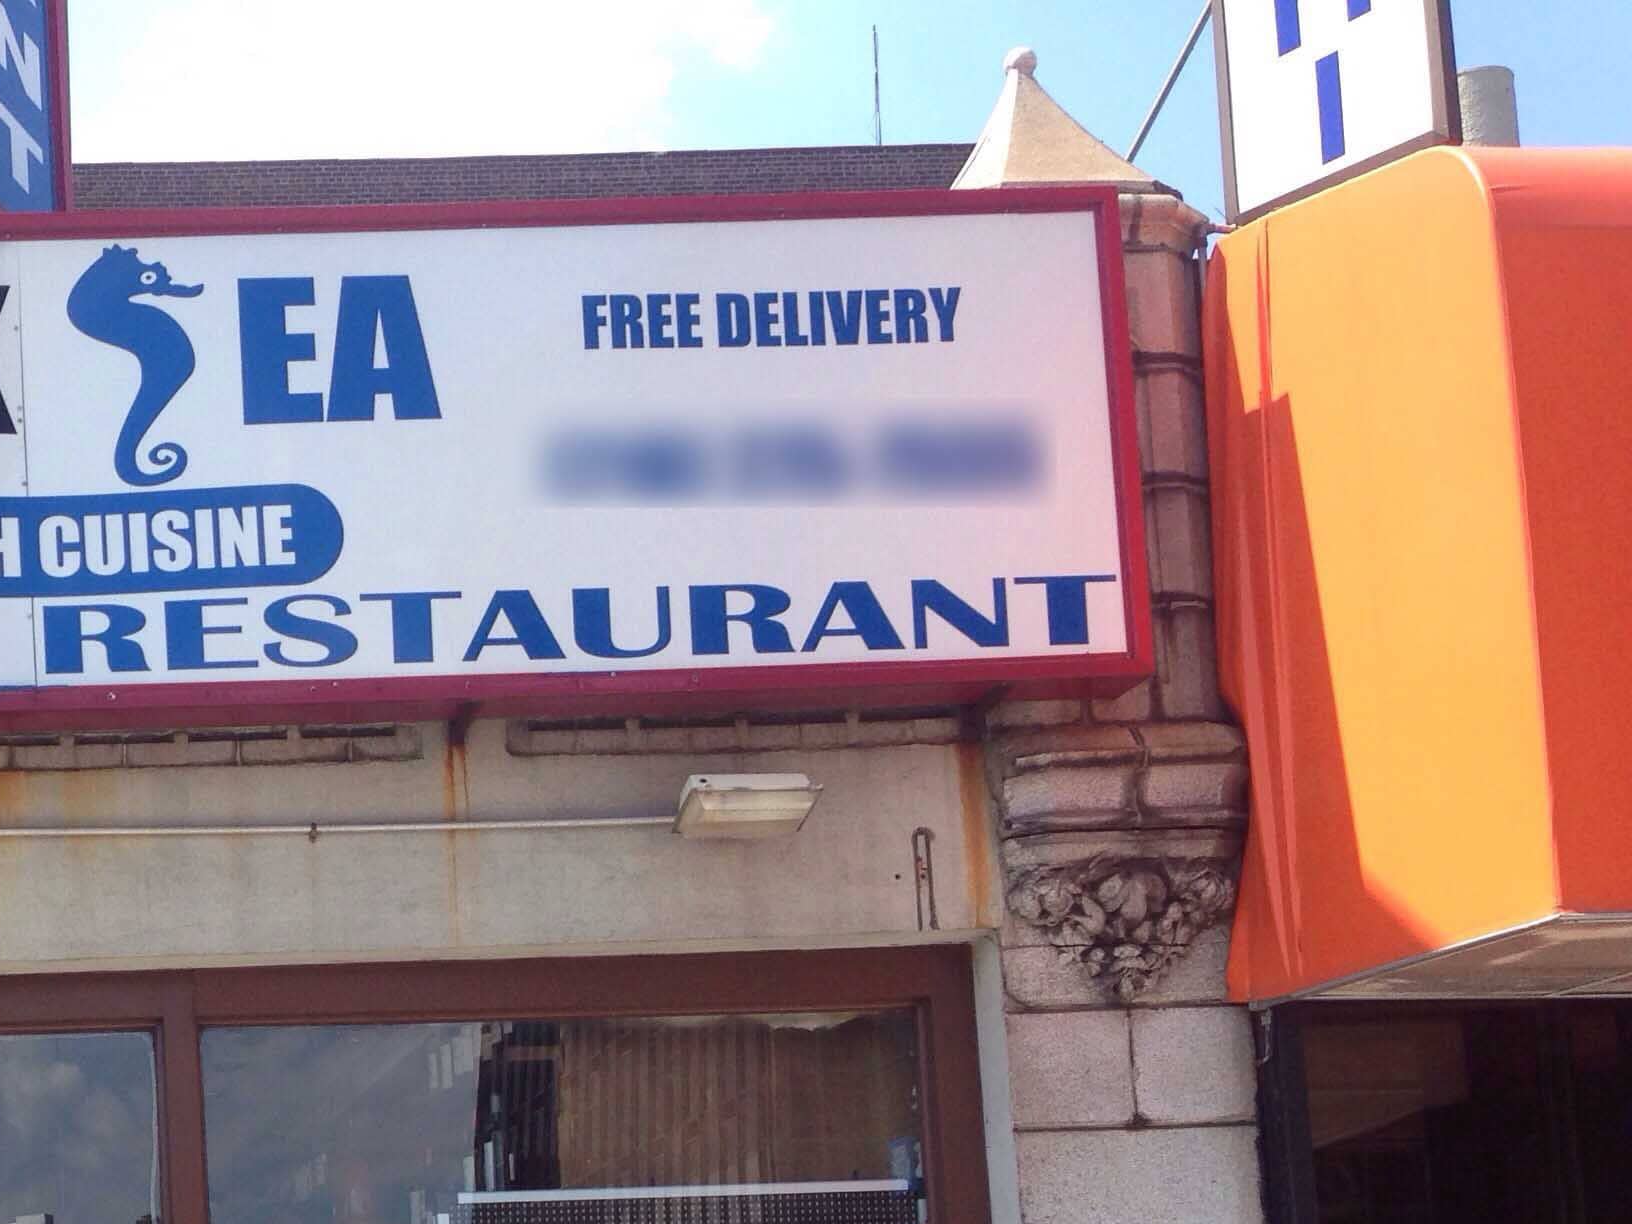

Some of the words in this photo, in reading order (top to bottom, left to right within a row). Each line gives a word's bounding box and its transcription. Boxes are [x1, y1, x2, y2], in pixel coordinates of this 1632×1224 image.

[581, 293, 704, 350] FREE
[716, 286, 962, 348] DELIVERY
[37, 504, 296, 575] CUISINE
[43, 573, 1117, 675] RESTAURANT
